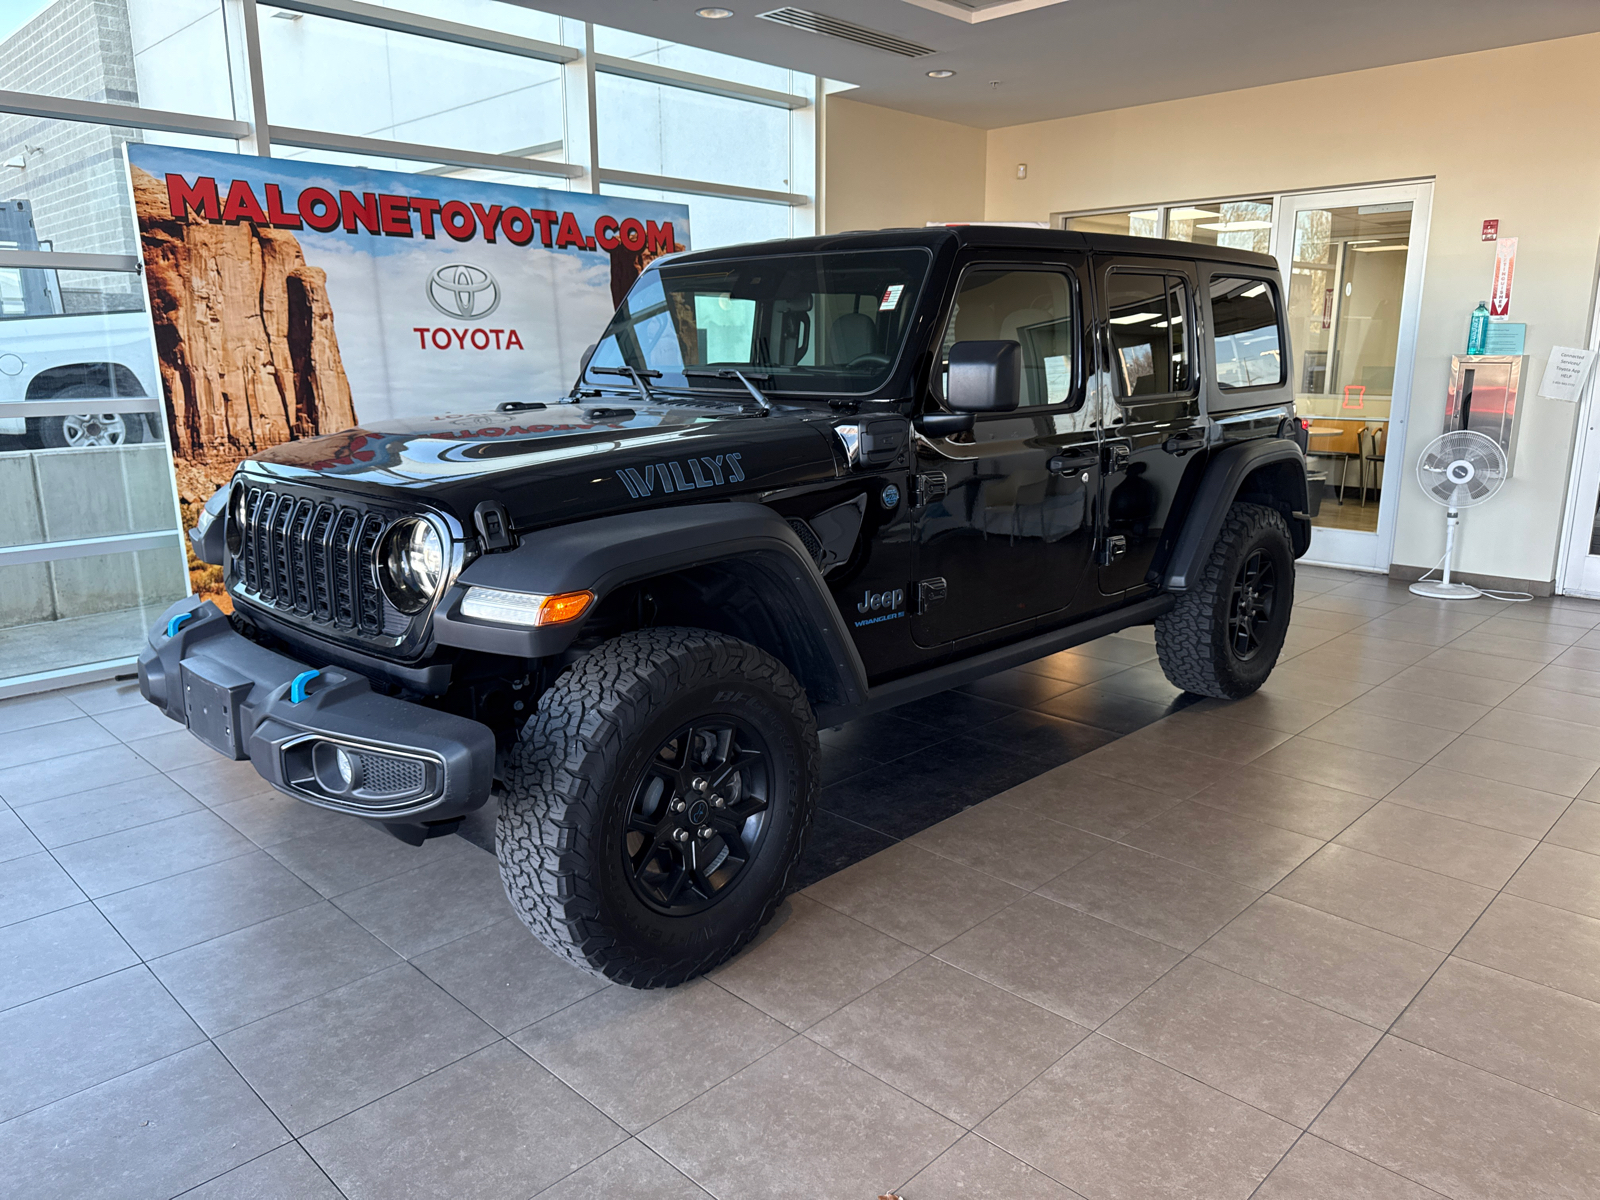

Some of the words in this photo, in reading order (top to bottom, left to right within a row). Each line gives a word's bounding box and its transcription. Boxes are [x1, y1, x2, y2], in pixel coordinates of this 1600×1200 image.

[165, 172, 676, 254] MALONETOYOTA.COM
[413, 327, 524, 351] TOYOTA
[1561, 352, 1585, 360] Connected
[615, 452, 746, 499] WILLYS
[857, 588, 904, 614] Jeep
[854, 612, 898, 628] WRANGLER
